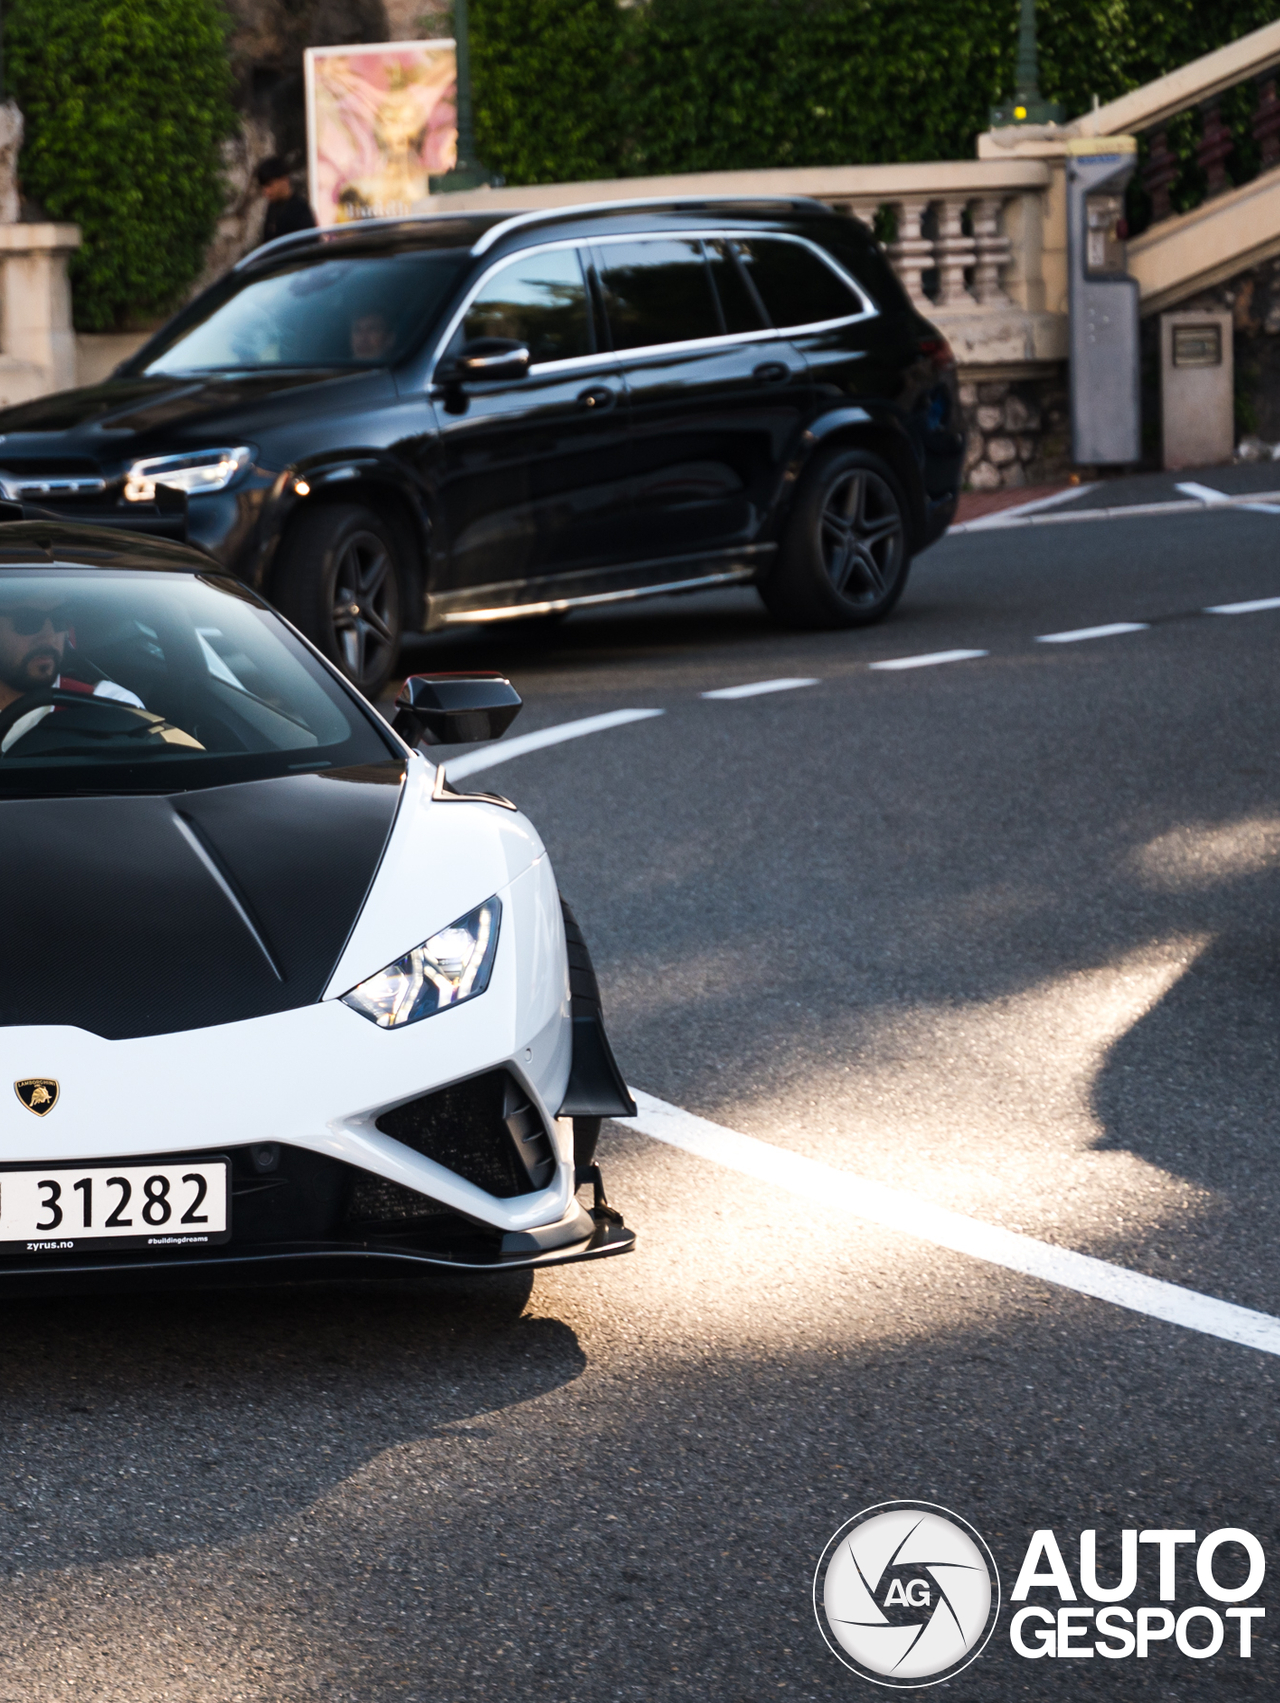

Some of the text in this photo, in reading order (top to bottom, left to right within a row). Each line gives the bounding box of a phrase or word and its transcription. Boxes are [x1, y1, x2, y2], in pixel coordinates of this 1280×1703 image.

[36, 1172, 209, 1231] 31282
[26, 1240, 74, 1251] zyrus.no
[147, 1235, 209, 1245] #buildingdreams
